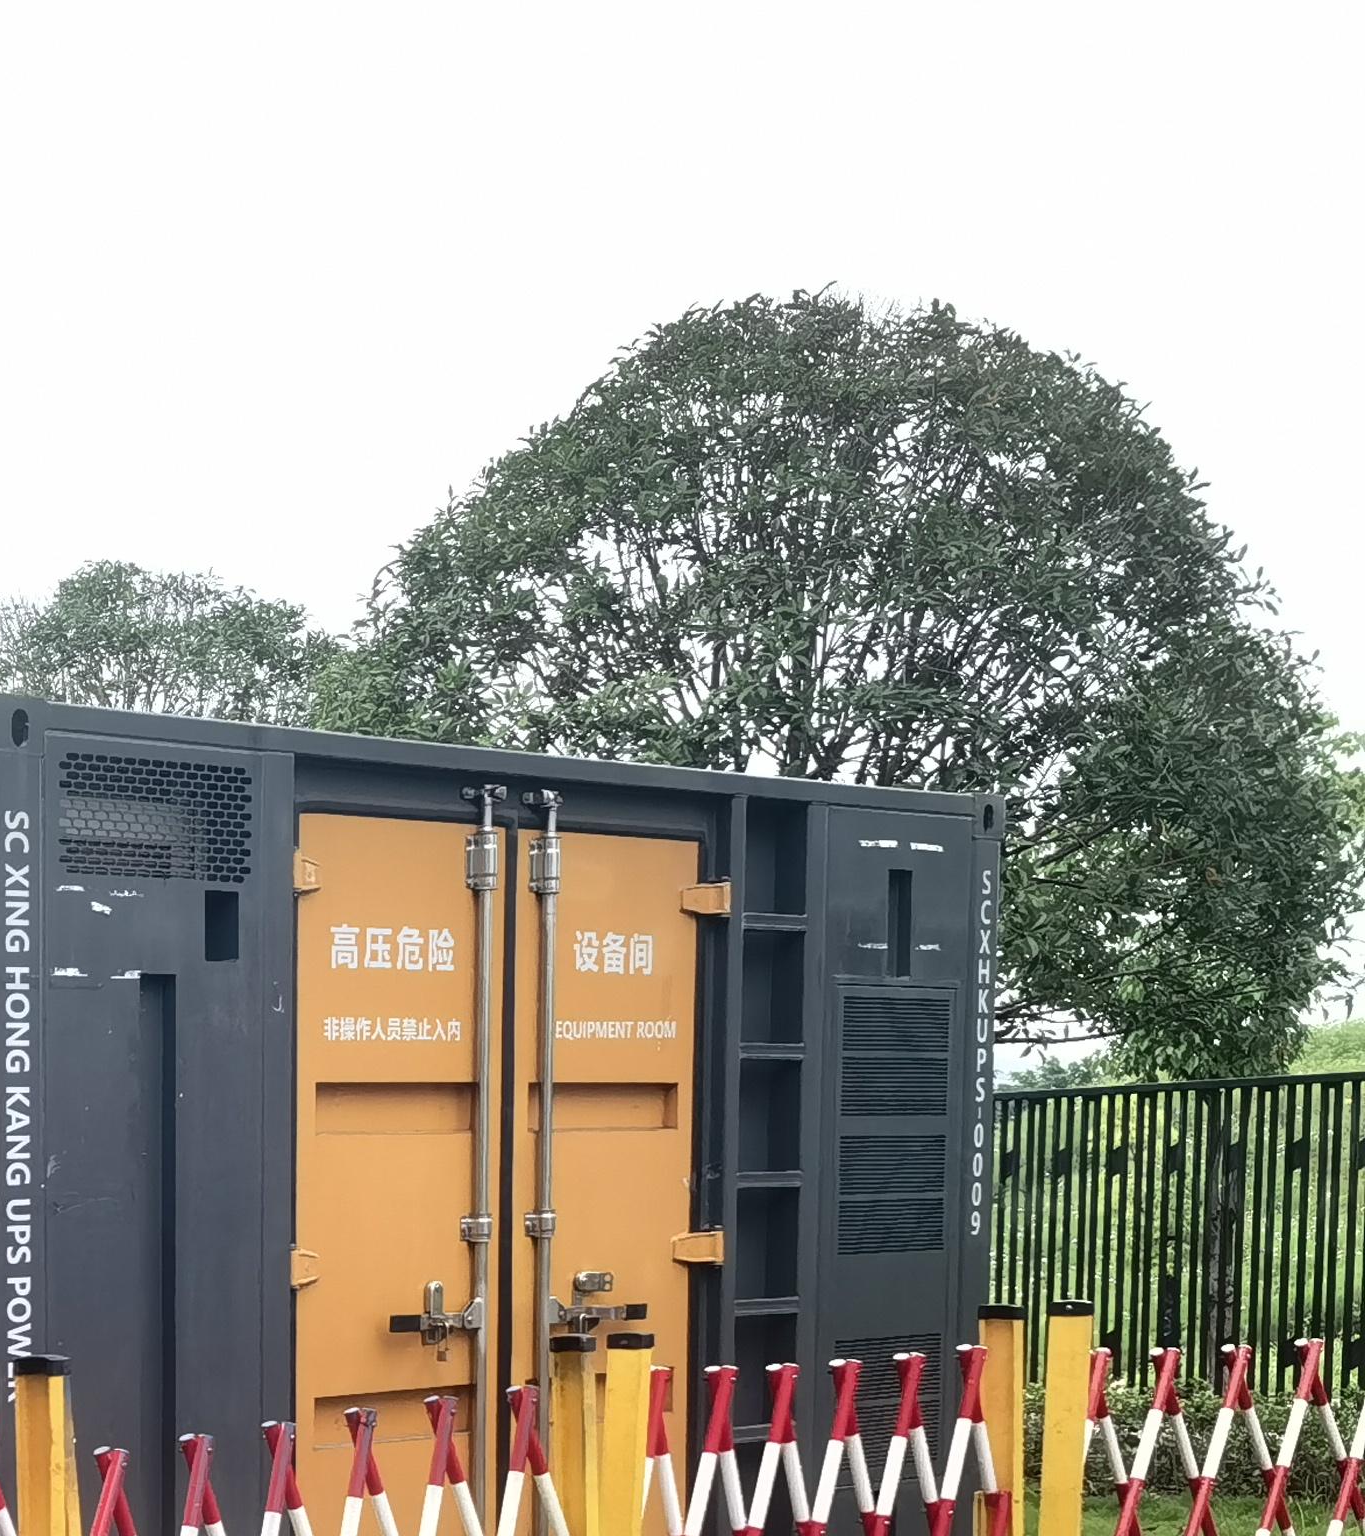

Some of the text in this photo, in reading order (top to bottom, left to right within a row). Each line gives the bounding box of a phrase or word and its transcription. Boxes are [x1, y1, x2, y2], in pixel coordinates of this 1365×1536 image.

[4, 810, 30, 854] SC
[4, 863, 31, 953] XING
[330, 923, 456, 972] 高压危险
[573, 930, 654, 977] 设备间
[4, 966, 32, 1074] HONG
[322, 1016, 462, 1042] 非操作人员禁止入内
[555, 1020, 678, 1041] EQUIPMENT ROOM
[970, 870, 992, 1236] SCXHKUPS-0009
[5, 1086, 32, 1187] KANG
[5, 1198, 32, 1265] UPS
